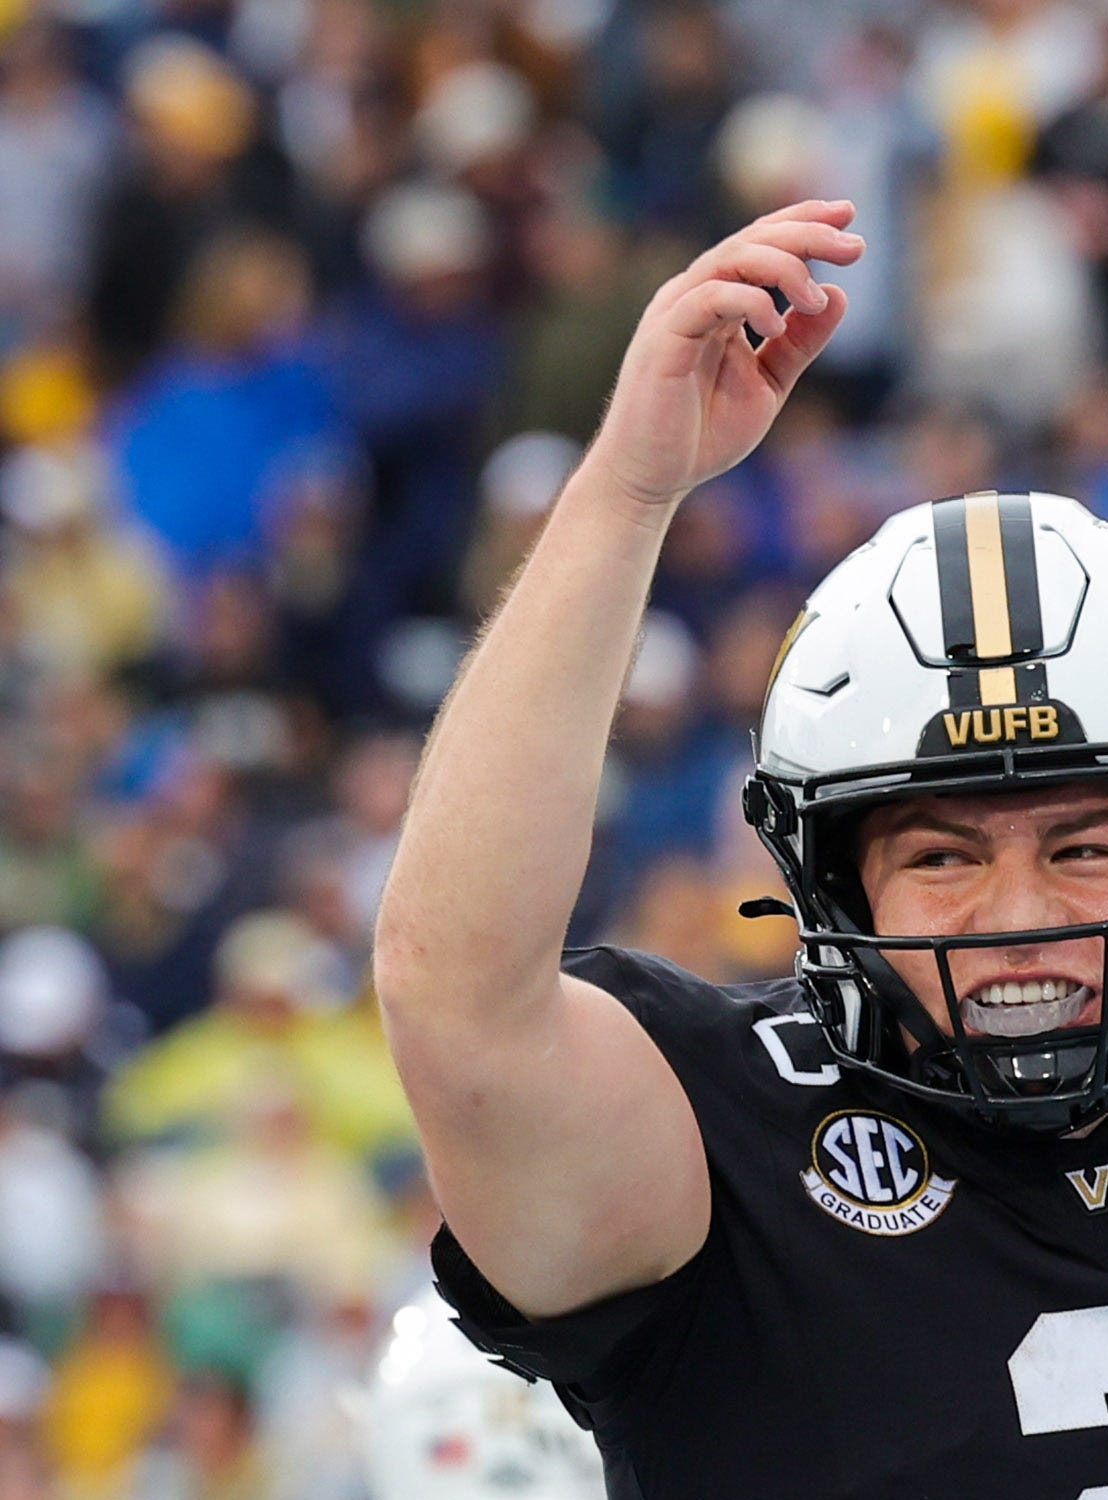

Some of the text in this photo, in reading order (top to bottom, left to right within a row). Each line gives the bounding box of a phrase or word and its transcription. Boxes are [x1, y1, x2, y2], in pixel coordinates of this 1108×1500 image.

[943, 705, 1059, 746] VUFB
[821, 1115, 919, 1202] SEC
[820, 1192, 941, 1231] GRADUATE
